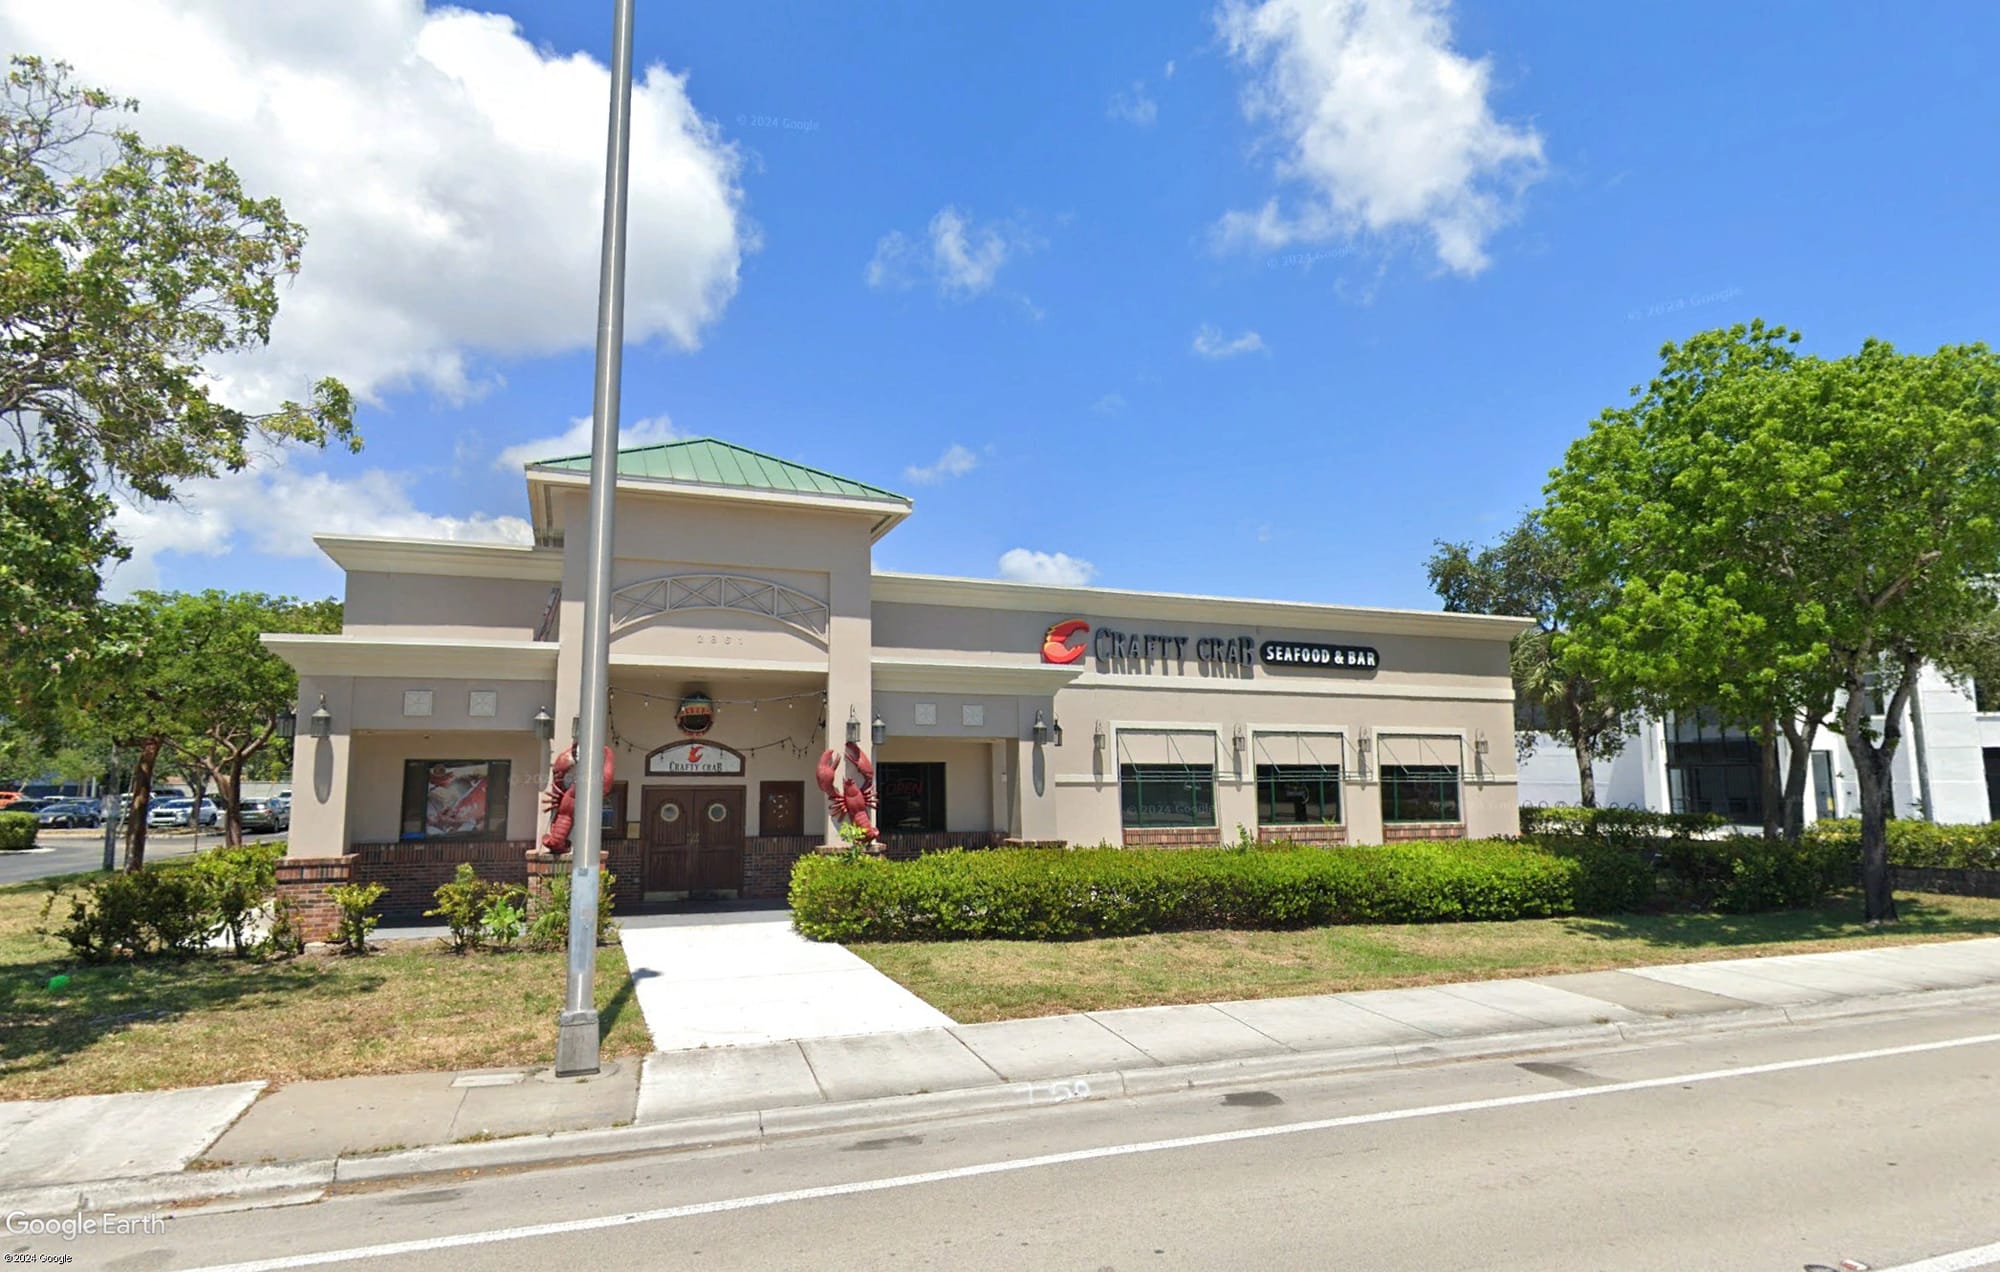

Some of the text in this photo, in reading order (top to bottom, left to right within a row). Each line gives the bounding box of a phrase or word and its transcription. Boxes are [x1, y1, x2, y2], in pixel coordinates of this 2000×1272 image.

[1095, 627, 1376, 667] CRAFTY CRAB SEAFOOD & BAR
